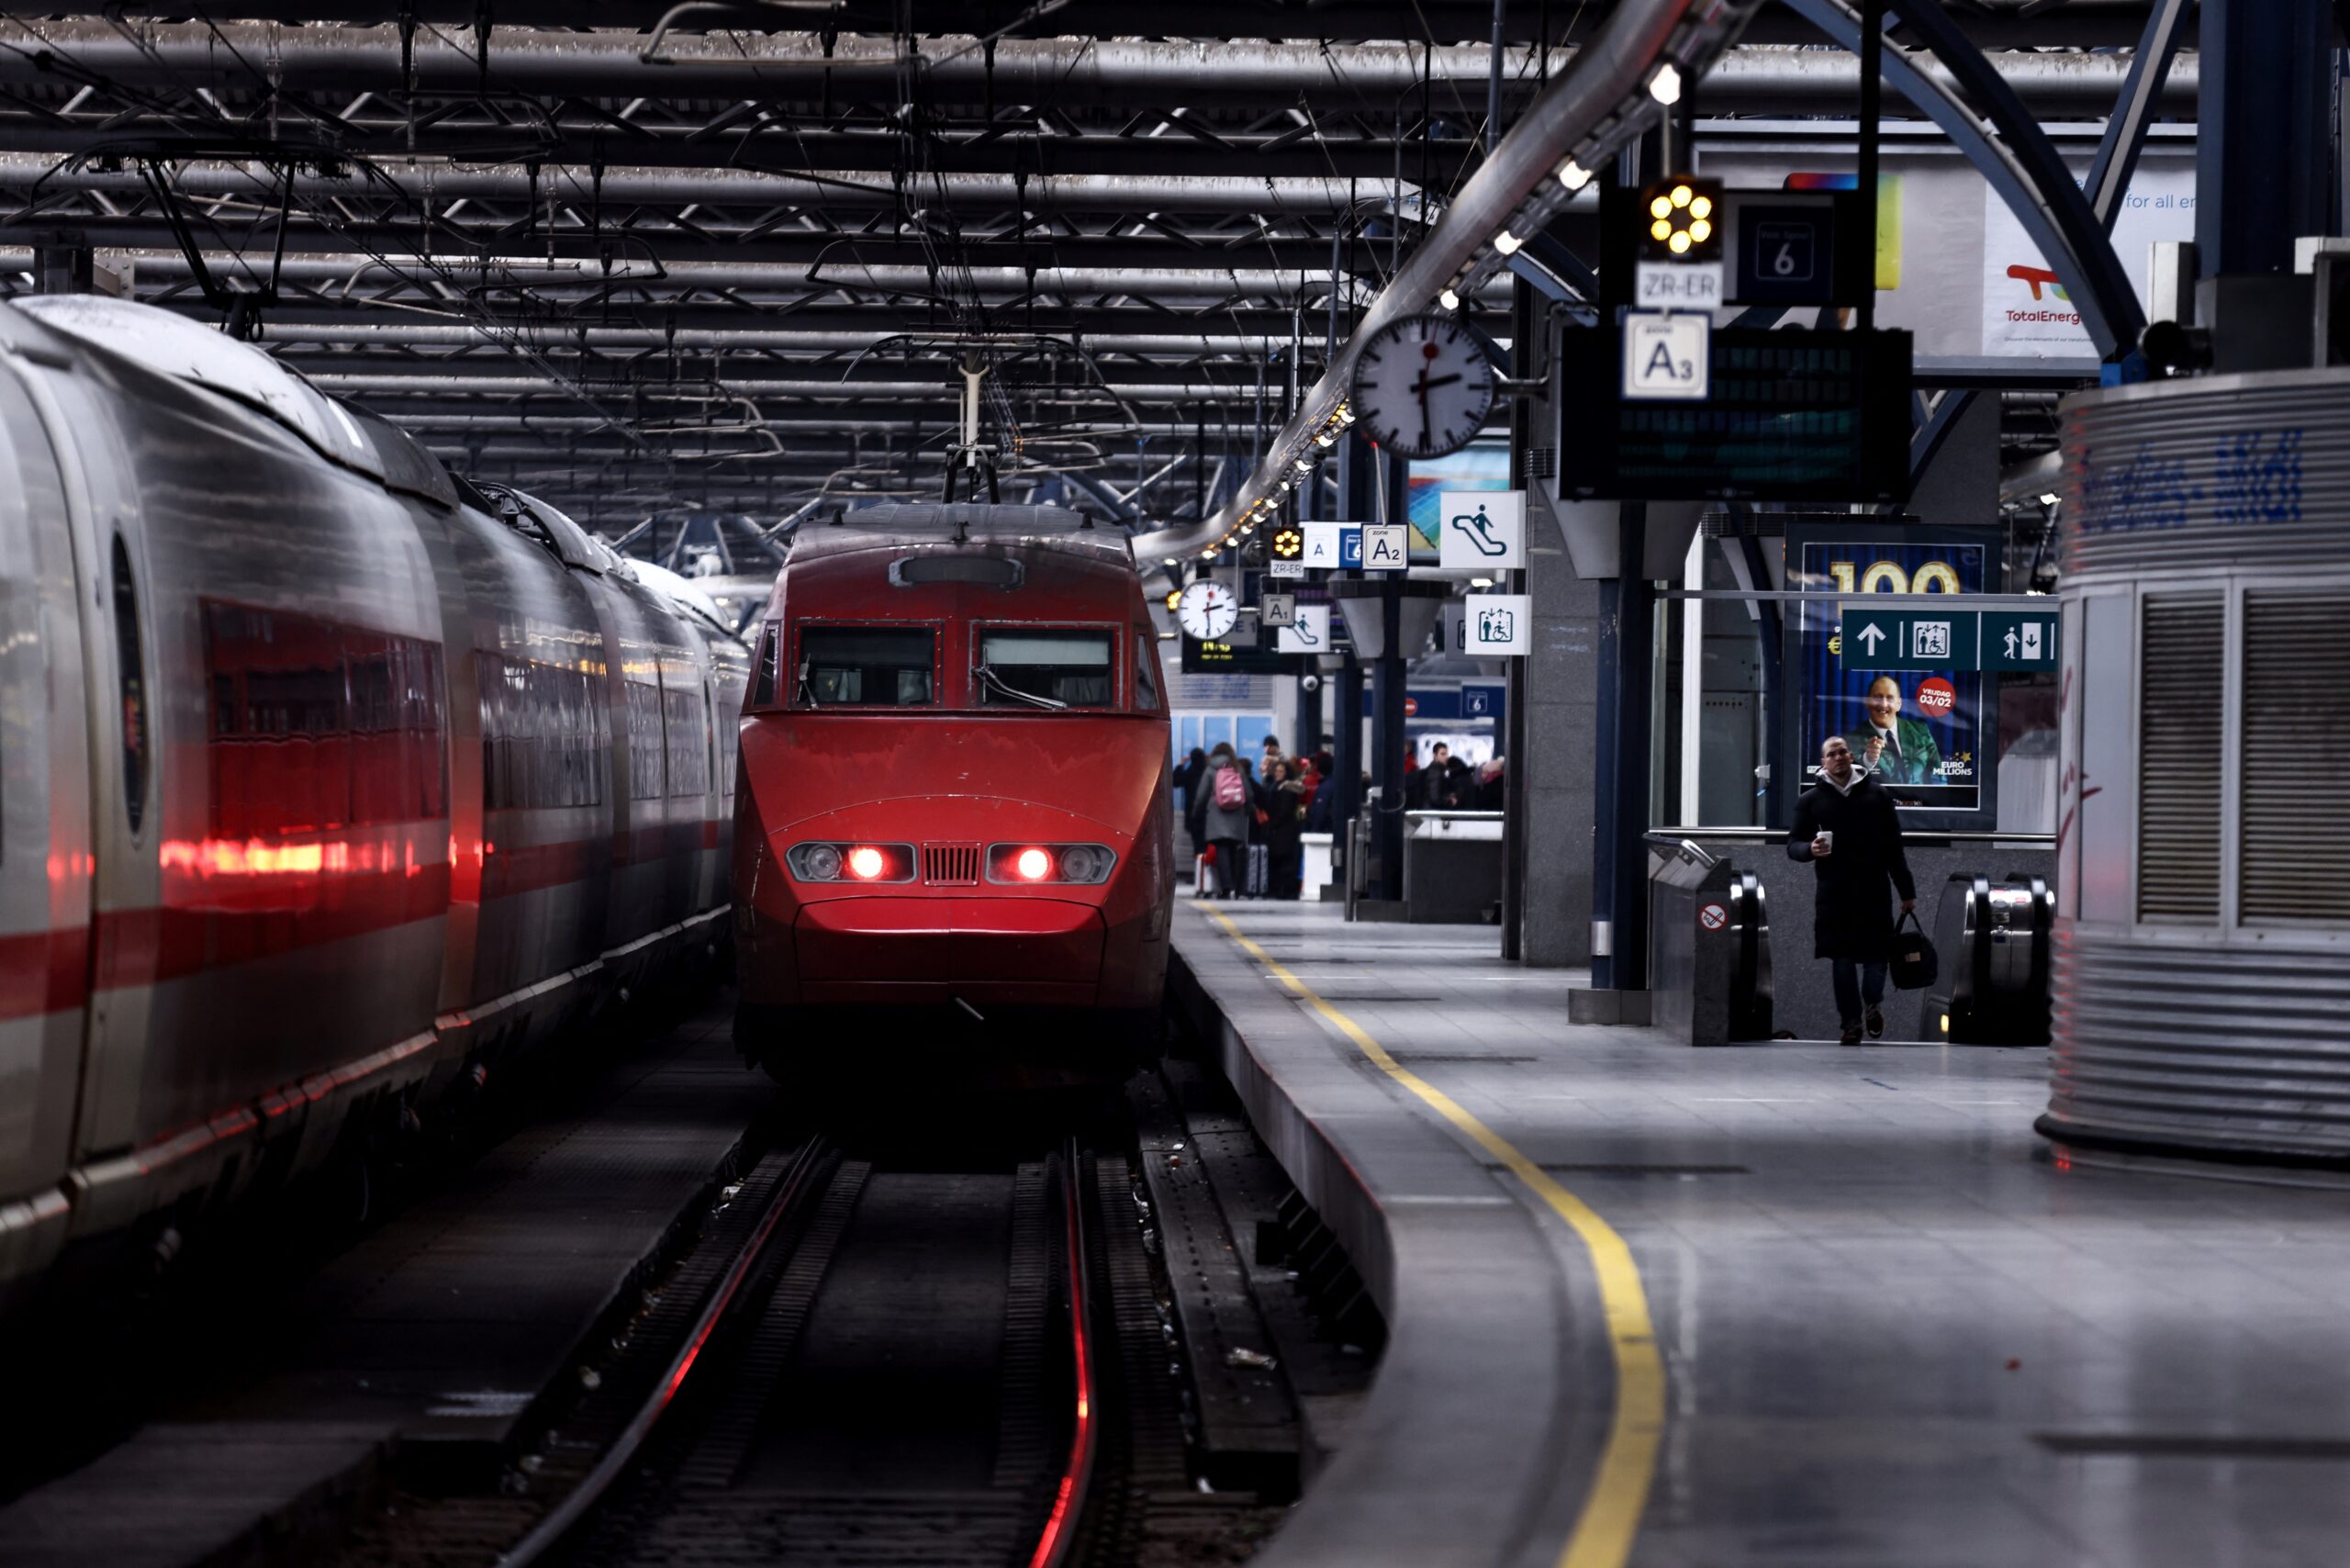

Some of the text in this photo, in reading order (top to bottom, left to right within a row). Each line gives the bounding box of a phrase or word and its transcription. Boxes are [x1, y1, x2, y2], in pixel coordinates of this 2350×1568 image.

[2126, 194, 2149, 208] for
[2155, 195, 2174, 208] all
[1774, 242, 1796, 275] 6
[1643, 272, 1716, 298] ZR-ER
[1314, 543, 1325, 556] A
[1273, 563, 1302, 574] ZR-ER
[1922, 688, 1952, 699] VRIJDAG
[1473, 699, 1482, 711] 6
[1919, 695, 1952, 708] 03/02
[1932, 767, 1973, 776] MILLIONS
